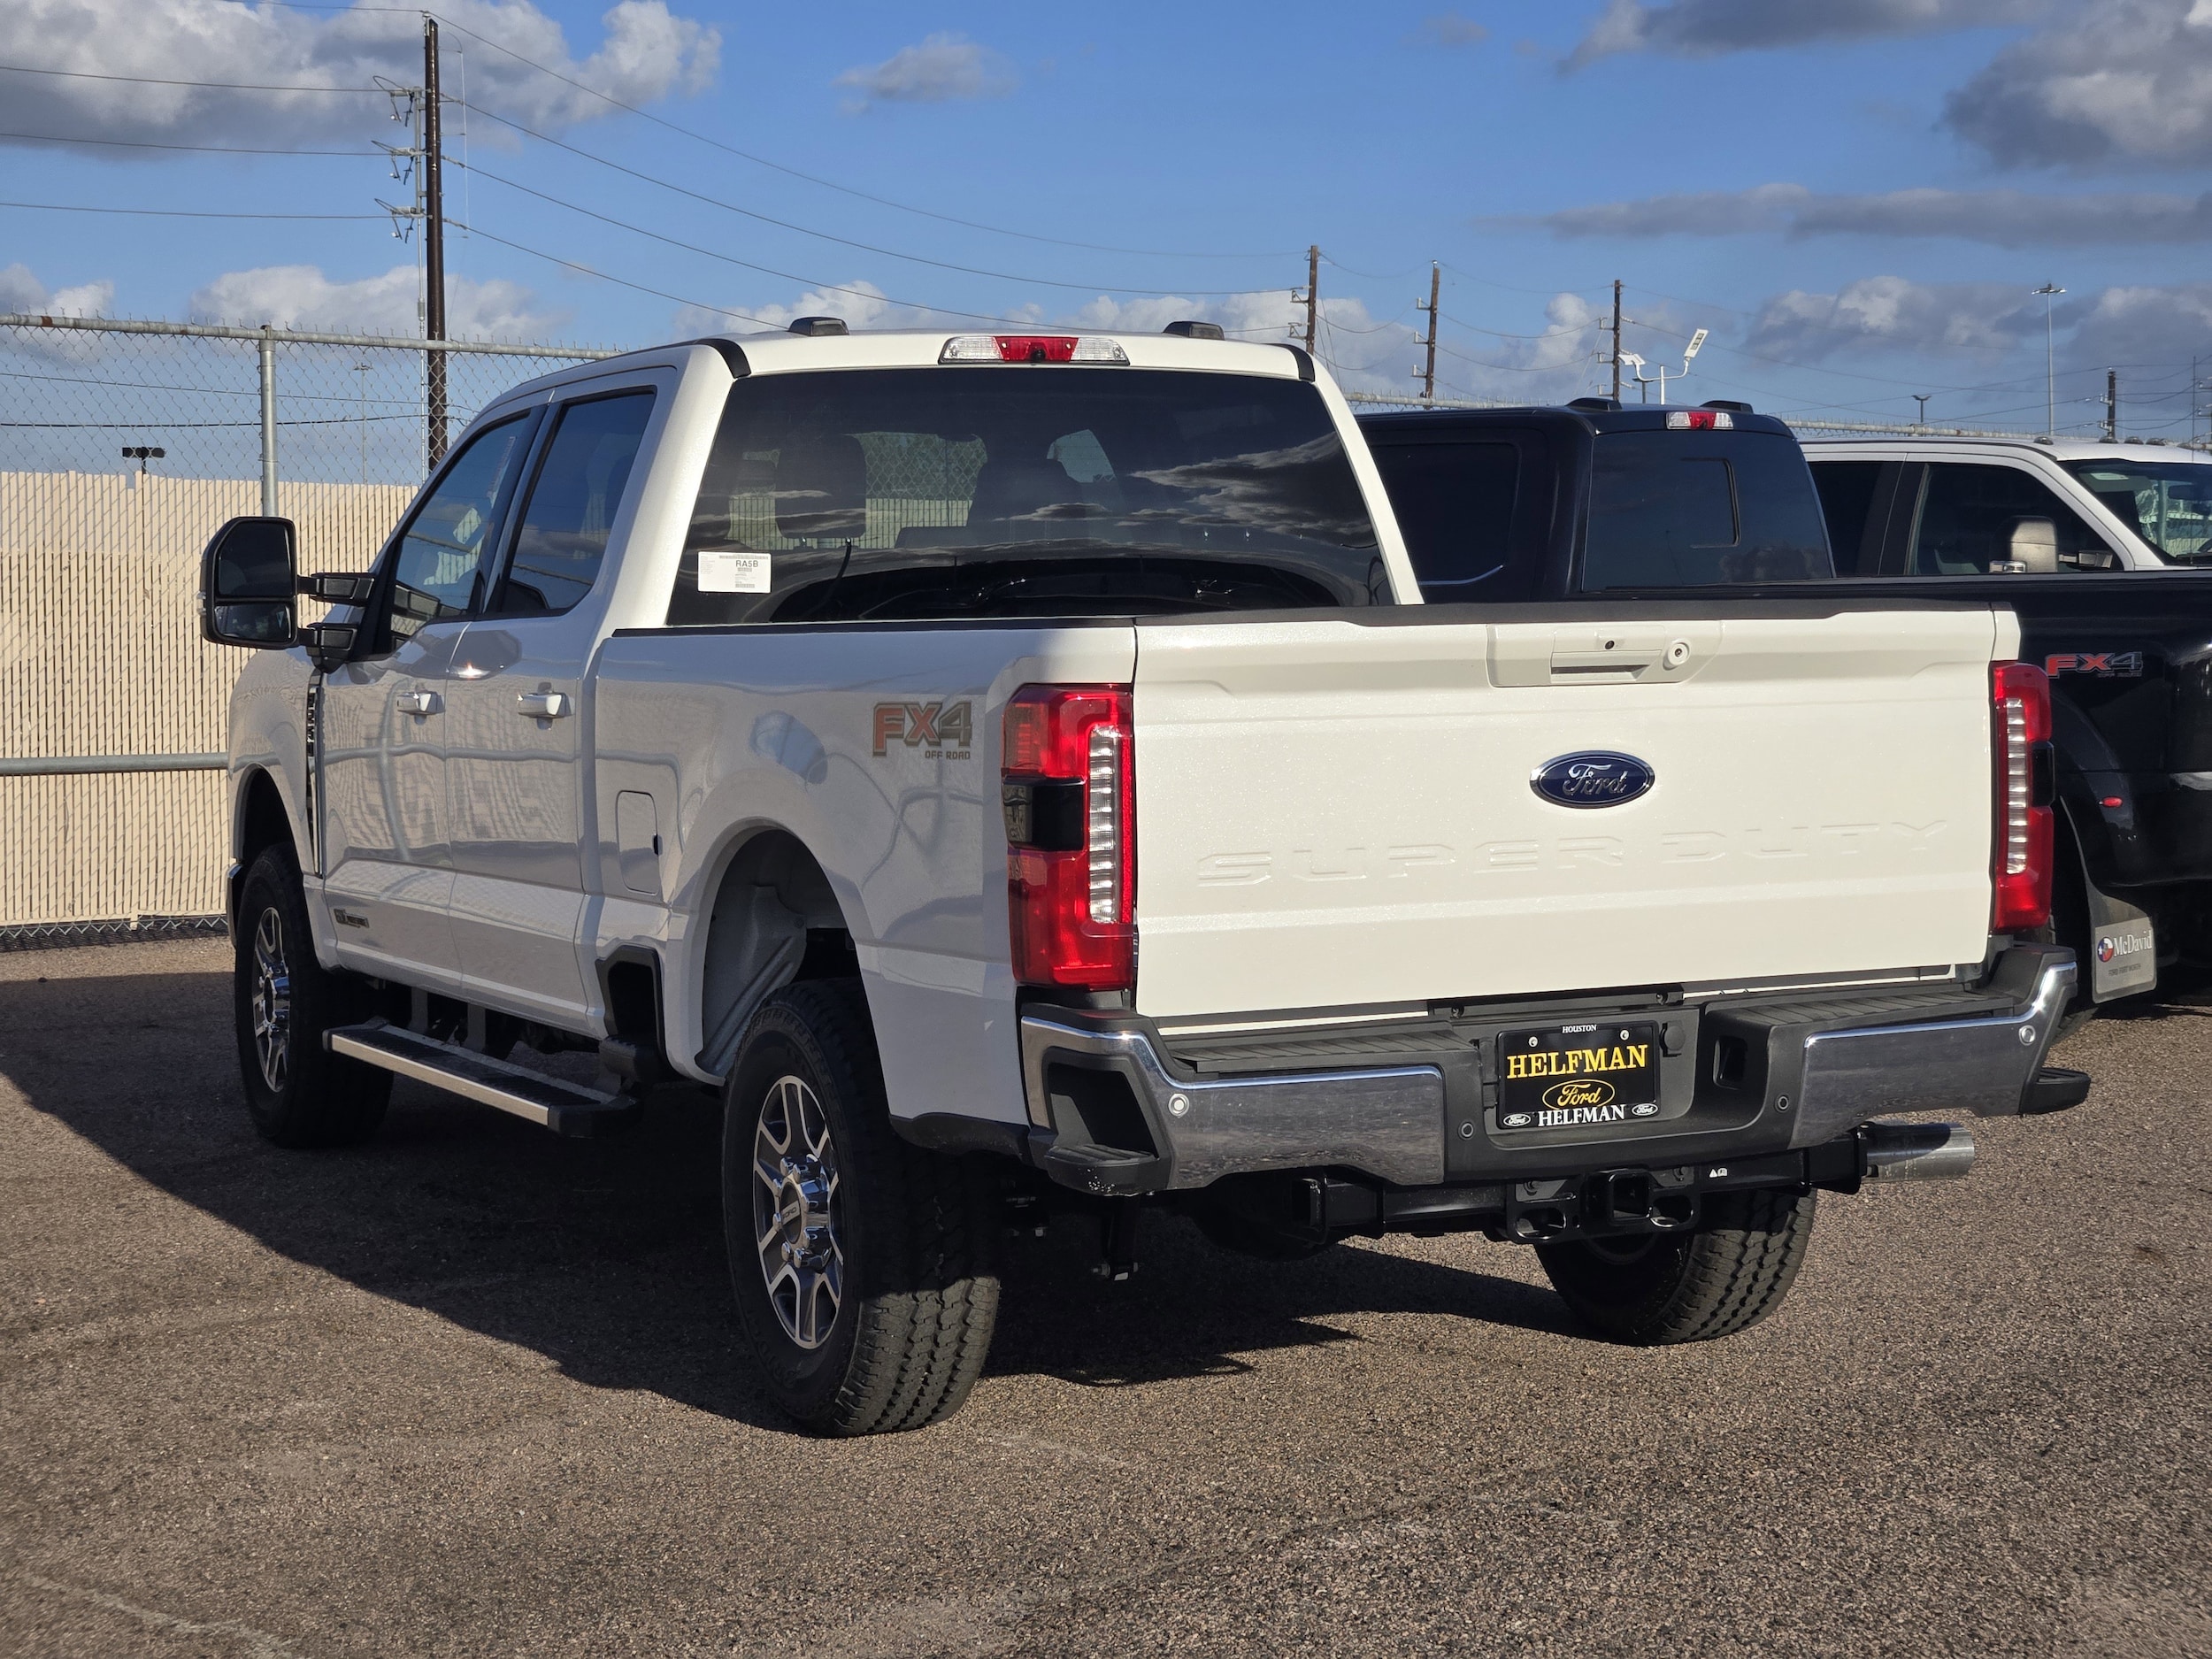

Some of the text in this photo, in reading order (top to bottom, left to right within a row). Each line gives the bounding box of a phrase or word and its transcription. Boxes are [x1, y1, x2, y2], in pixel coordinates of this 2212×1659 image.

[2045, 651, 2144, 679] FX4
[872, 701, 972, 757] FX4
[925, 750, 971, 760] OFF ROAD
[1562, 763, 1628, 795] Ford
[1197, 818, 1947, 887] SUPER DUTY
[2113, 930, 2153, 956] McDavid
[1562, 1024, 1597, 1033] HOUSTON
[1507, 1044, 1648, 1079] HELFMAN
[1557, 1083, 1601, 1106] Ford
[1538, 1104, 1627, 1127] HELFMAN
